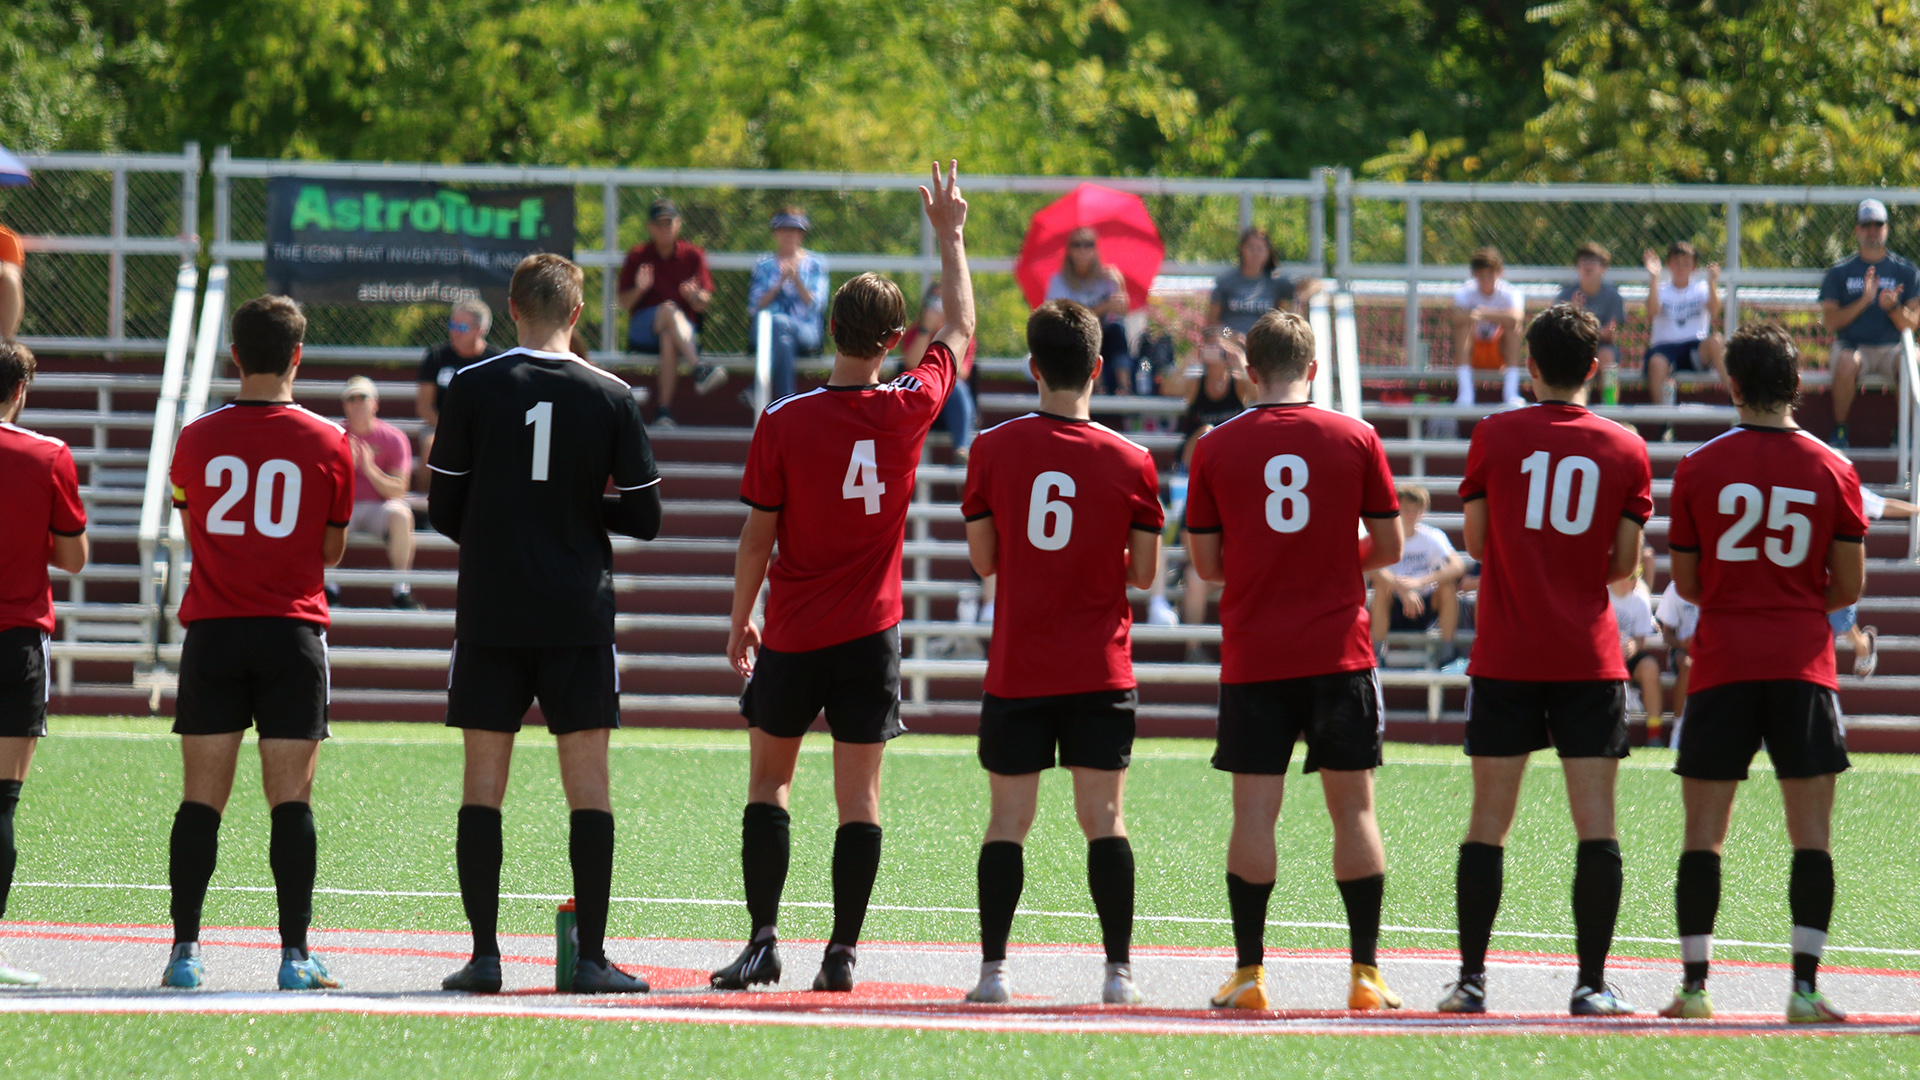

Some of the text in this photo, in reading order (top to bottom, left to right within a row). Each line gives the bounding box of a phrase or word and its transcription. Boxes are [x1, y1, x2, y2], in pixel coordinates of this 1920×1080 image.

[290, 184, 545, 240] AstroTurf
[274, 243, 303, 262] THE
[304, 243, 343, 263] ICON
[345, 244, 384, 262] THAT
[386, 246, 460, 265] INVENTED
[462, 250, 490, 268] THE
[357, 281, 481, 302] astroturf.com
[525, 401, 553, 481] 1
[842, 439, 886, 515] 4
[205, 455, 302, 538] 20
[1027, 470, 1076, 551] 6
[1264, 453, 1310, 533] 8
[1520, 450, 1600, 535] 10
[1717, 482, 1816, 567] 25
